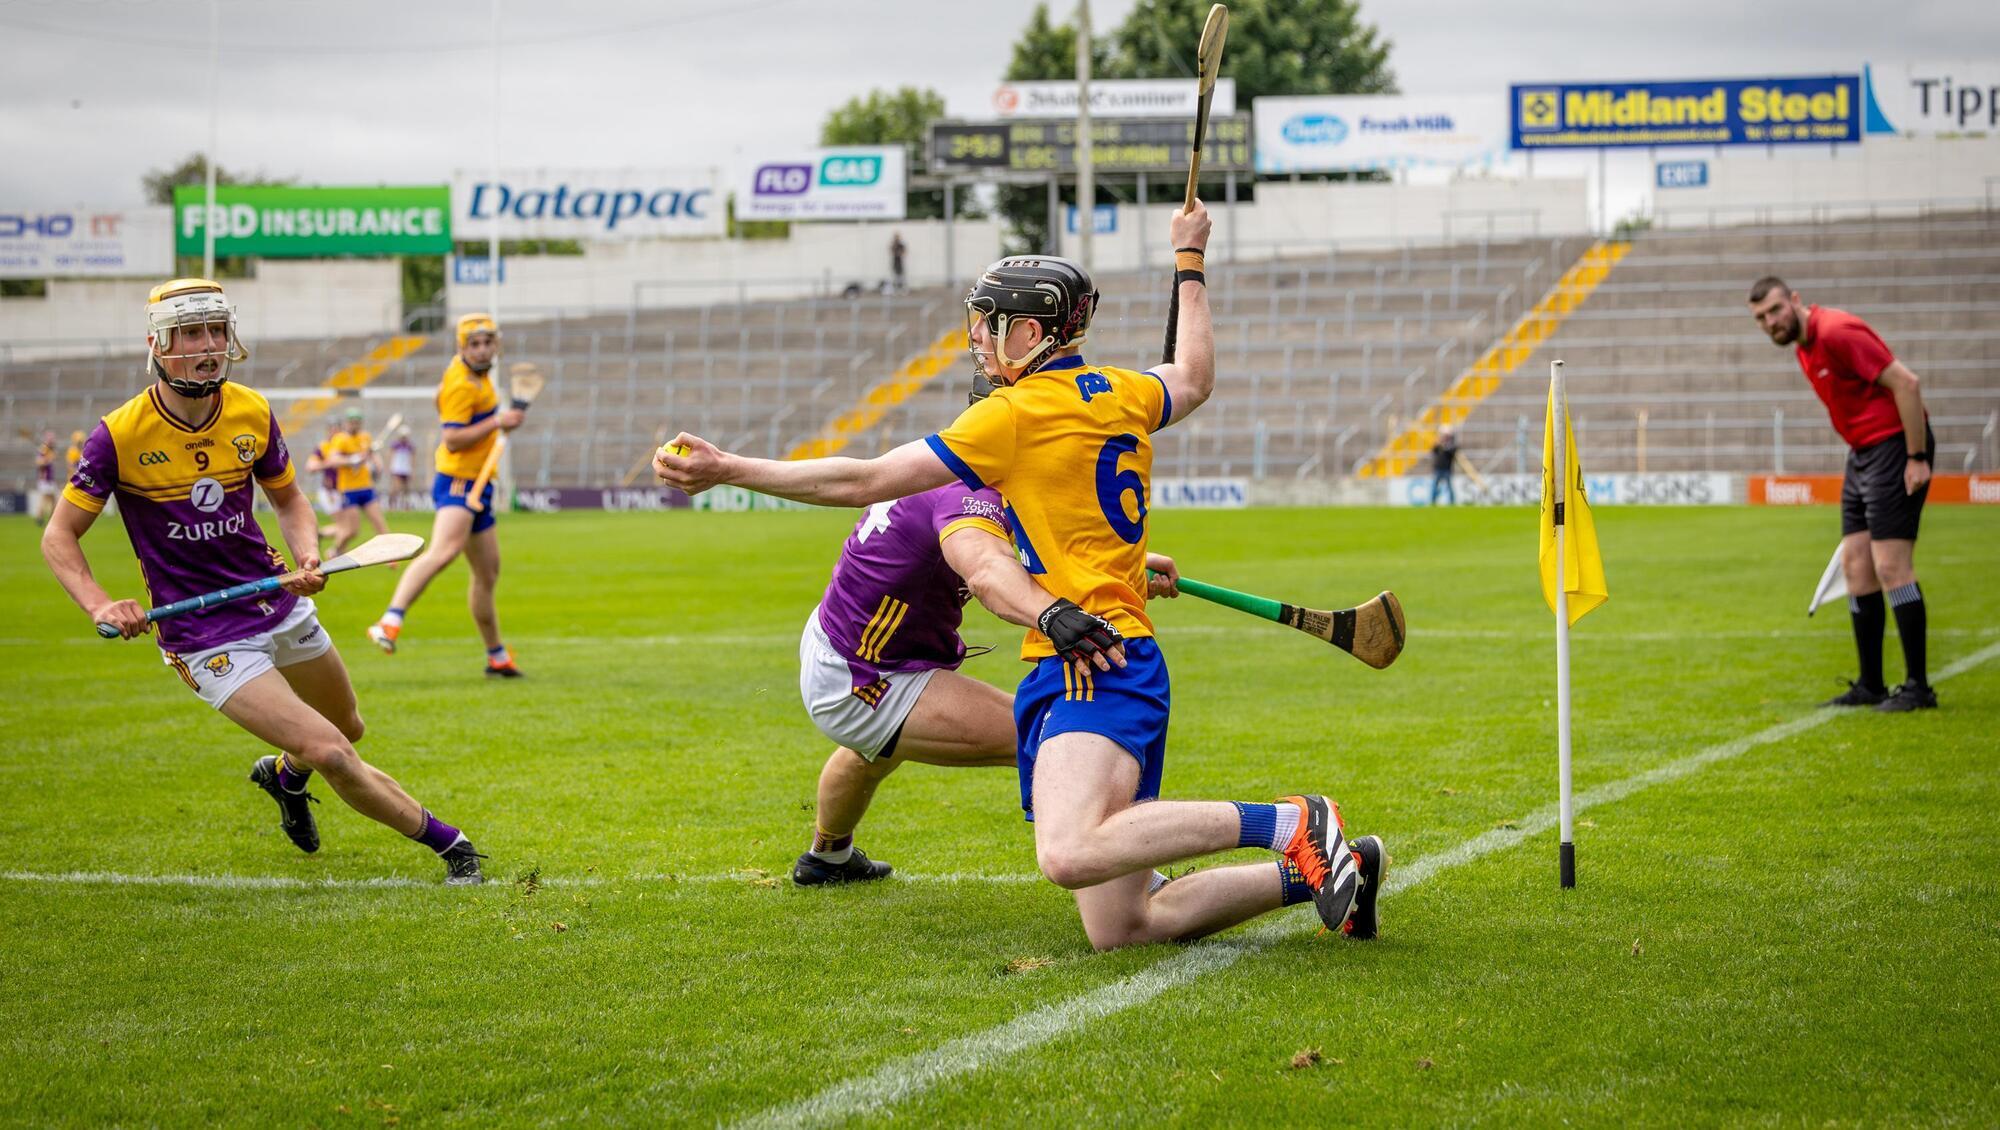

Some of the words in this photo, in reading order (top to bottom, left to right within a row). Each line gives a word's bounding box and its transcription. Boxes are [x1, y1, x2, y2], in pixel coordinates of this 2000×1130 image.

[1565, 88, 1726, 126] Midland
[1739, 84, 1848, 123] Steel
[760, 168, 807, 192] FLO
[825, 159, 876, 181] GAS
[1660, 165, 1704, 185] EXIT
[469, 183, 712, 229] Datapac
[91, 213, 125, 238] IT
[183, 205, 258, 238] FBD
[262, 208, 442, 236] INSURANCE
[194, 451, 210, 472] 9
[602, 489, 673, 513] UPMC
[1095, 433, 1147, 545] 6
[1162, 485, 1244, 504] UNION
[1624, 473, 1711, 504] SIGNS
[963, 505, 993, 517] YOUR
[967, 499, 1006, 519] TACKLE
[167, 511, 245, 541] ZURICH
